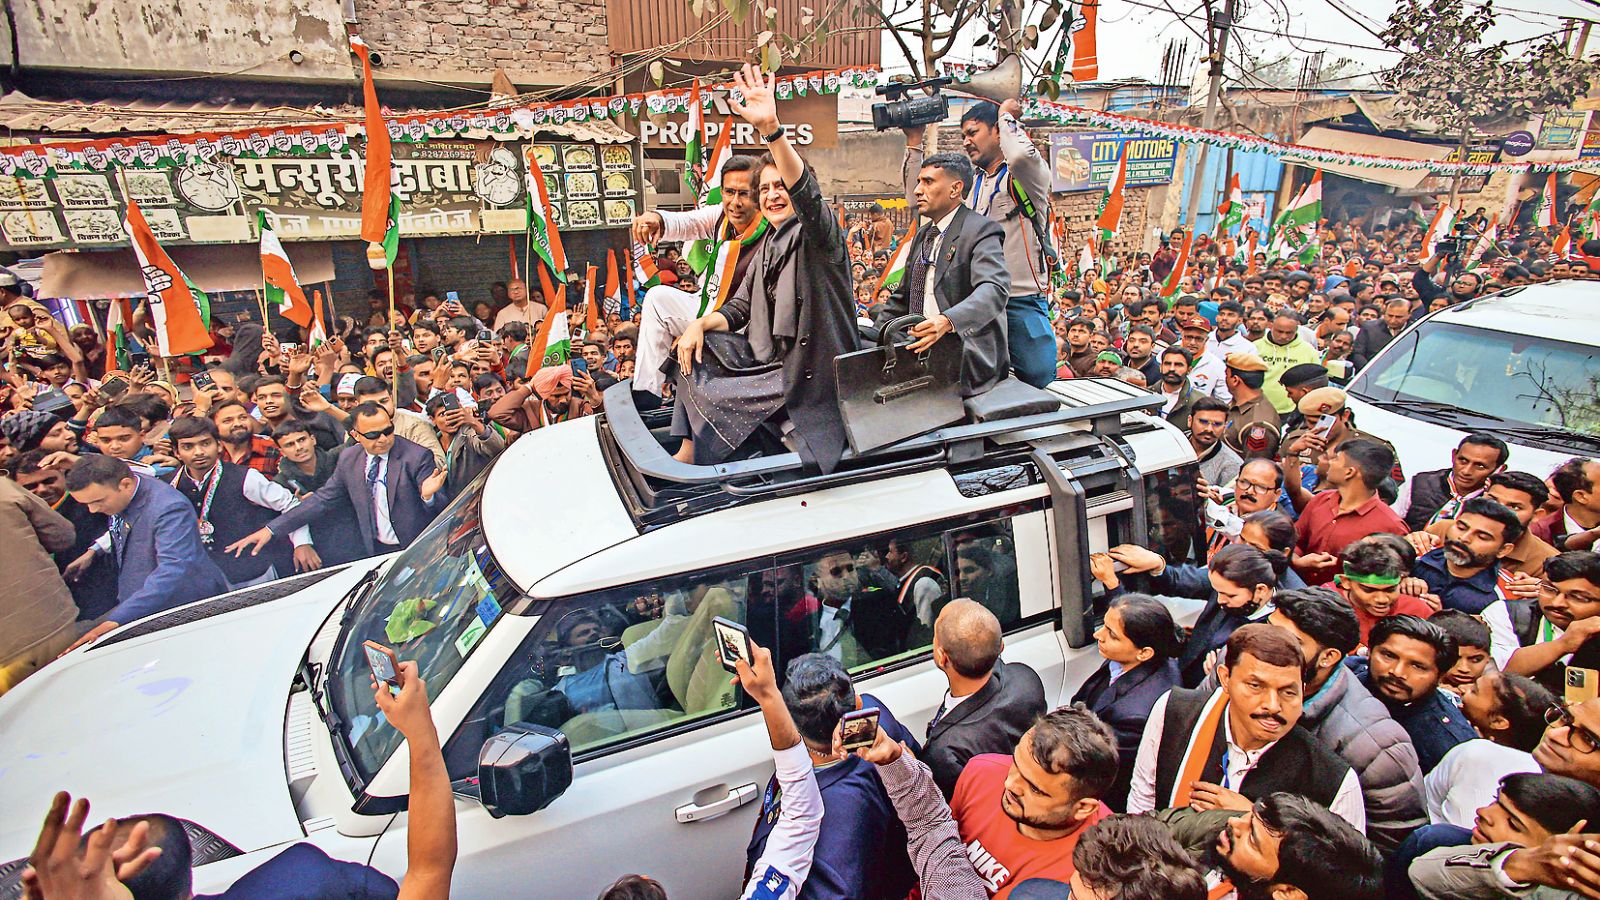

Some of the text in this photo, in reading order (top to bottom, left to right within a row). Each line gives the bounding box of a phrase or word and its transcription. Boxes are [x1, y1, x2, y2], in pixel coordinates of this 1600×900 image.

[640, 121, 814, 145] PRPERES
[1092, 141, 1120, 161] CITY
[1126, 140, 1174, 160] MOTORS
[966, 839, 1011, 893] NIKE
